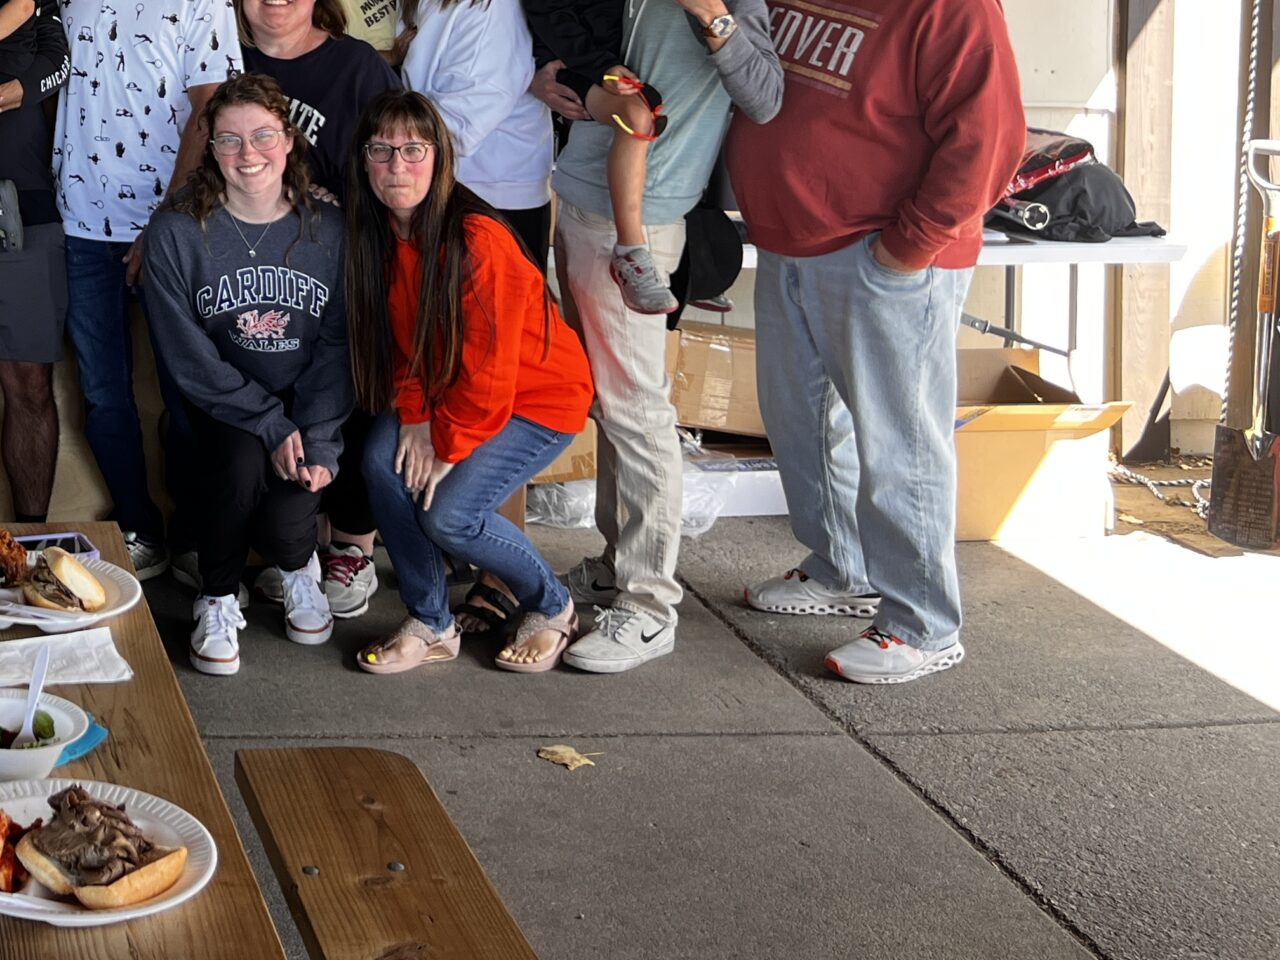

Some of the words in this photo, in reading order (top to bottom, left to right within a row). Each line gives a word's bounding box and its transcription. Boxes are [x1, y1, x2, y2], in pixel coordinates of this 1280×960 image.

[364, 4, 391, 28] BEST
[769, 7, 865, 77] ENVER
[283, 96, 326, 146] ATE
[196, 266, 329, 319] CARDIFF
[228, 330, 300, 353] WALES
